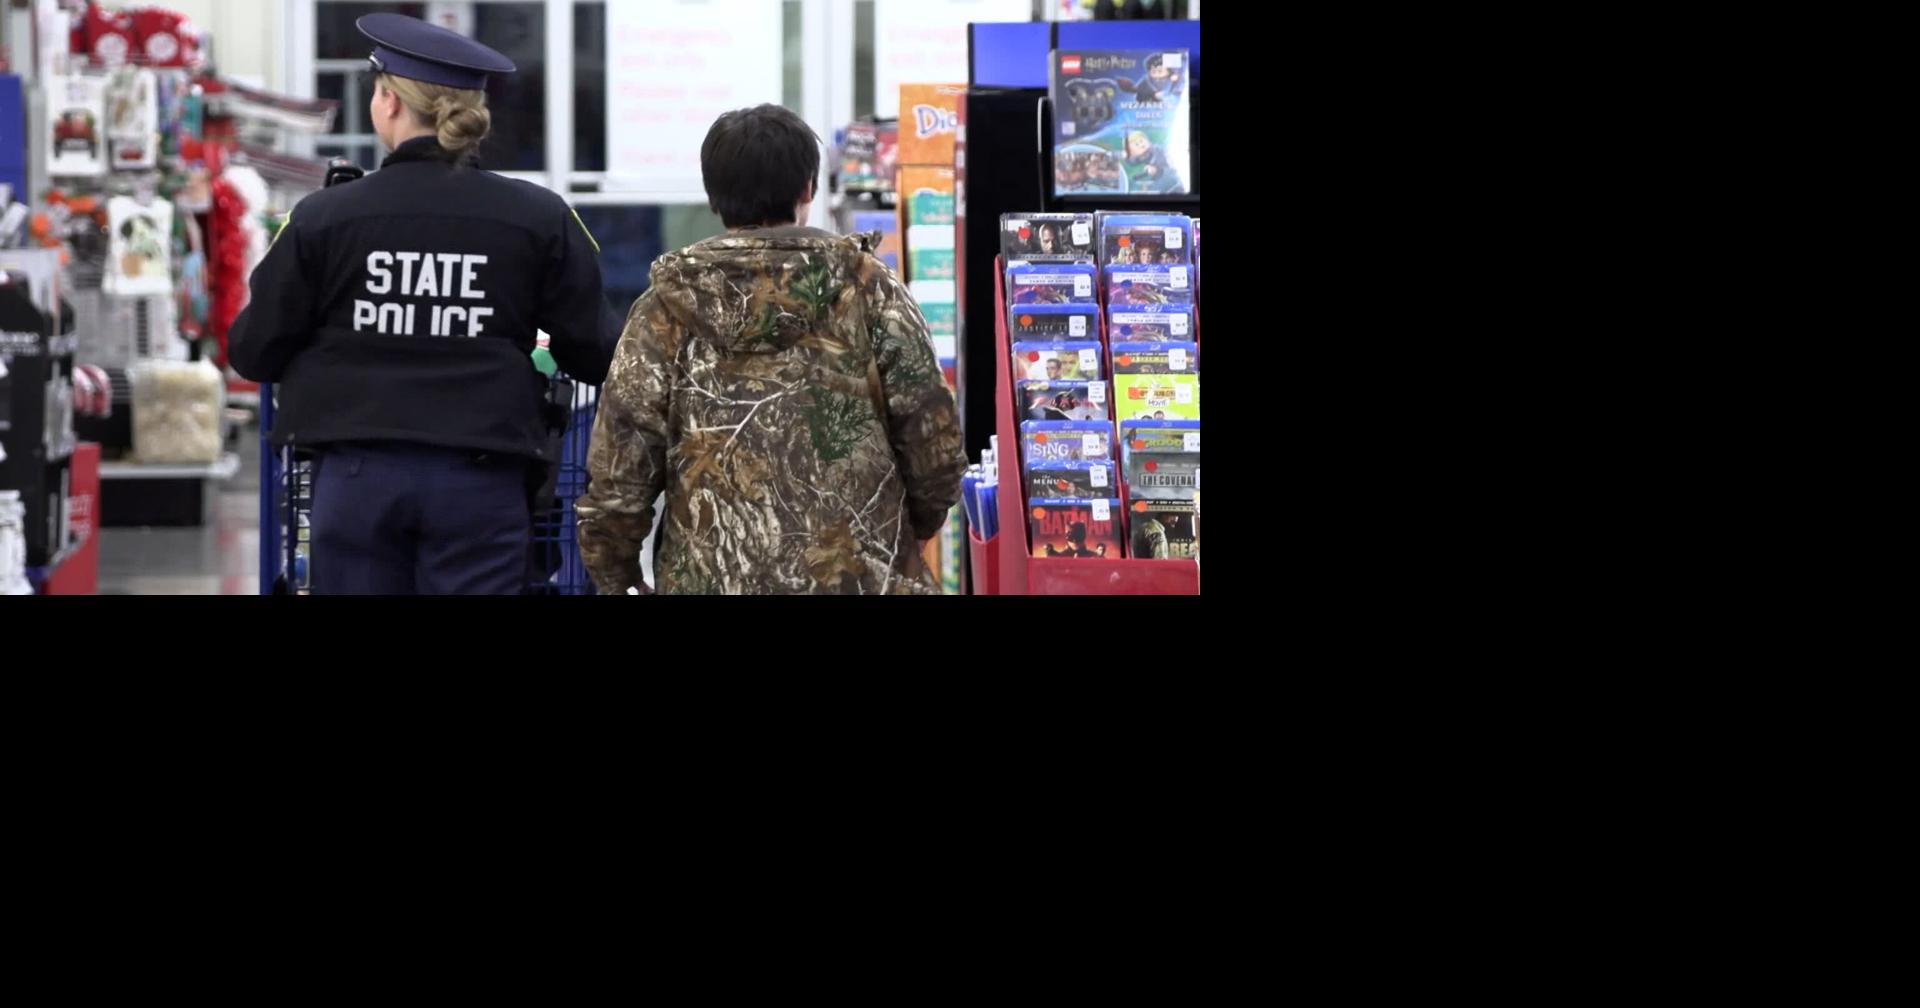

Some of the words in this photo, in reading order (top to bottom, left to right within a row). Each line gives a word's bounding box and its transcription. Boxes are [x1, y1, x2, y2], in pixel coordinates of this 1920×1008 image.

[366, 251, 488, 299] STATE
[353, 299, 494, 338] POLICE
[1032, 442, 1069, 457] SING
